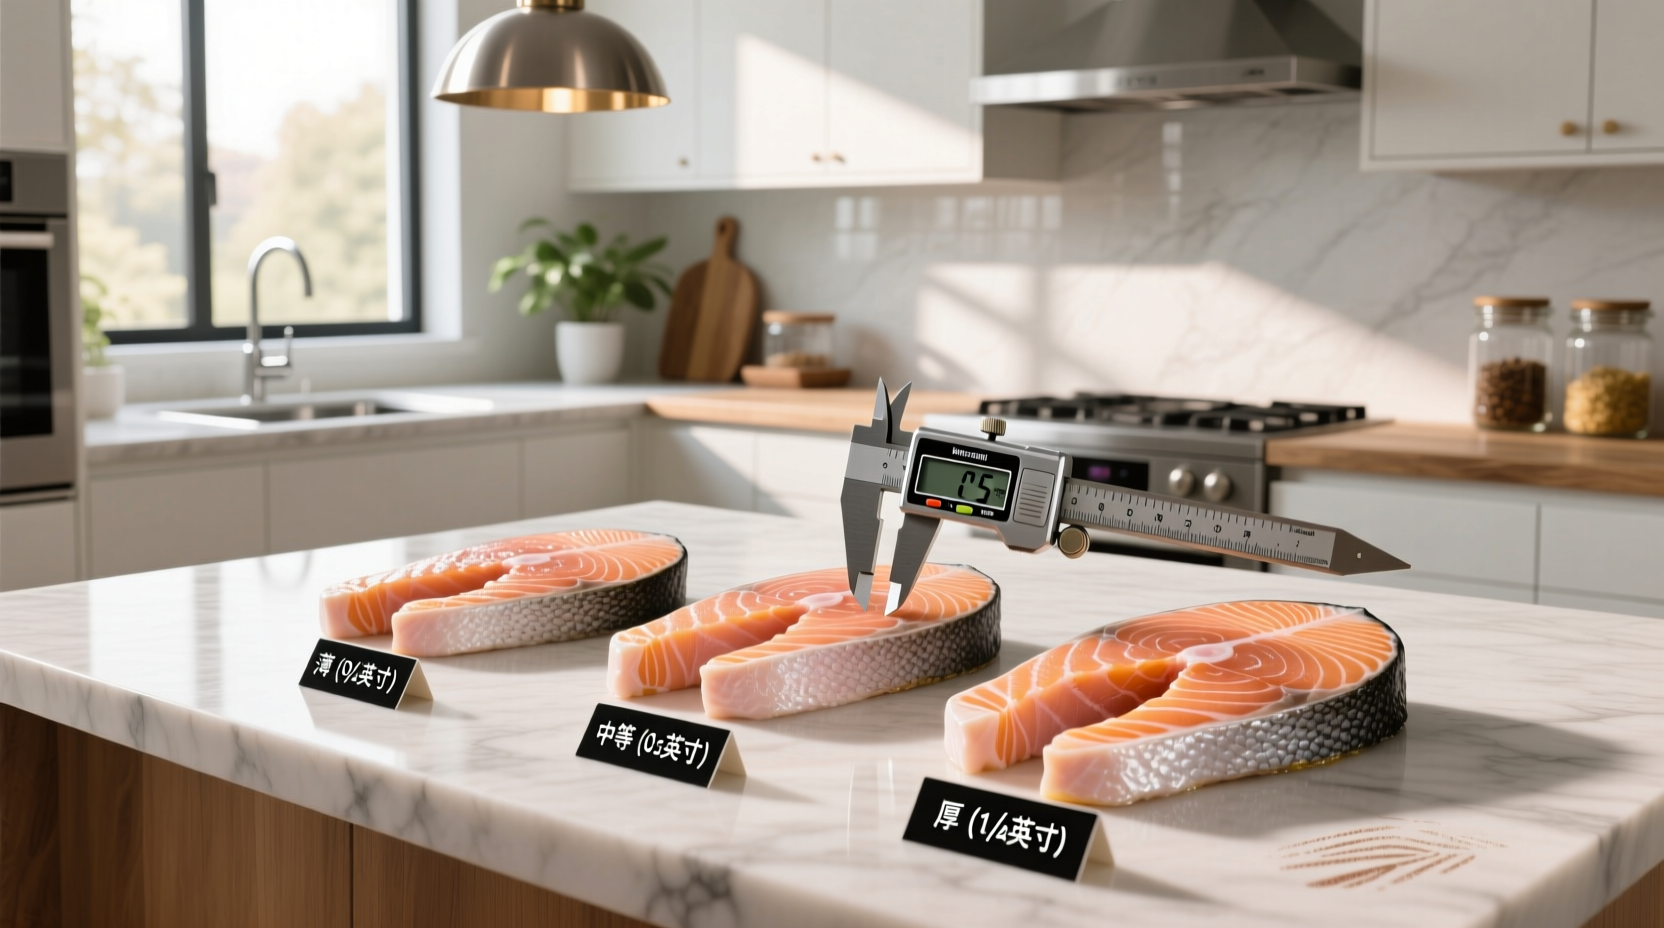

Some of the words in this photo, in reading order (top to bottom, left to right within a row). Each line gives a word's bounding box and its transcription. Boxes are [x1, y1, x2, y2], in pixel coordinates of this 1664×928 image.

[312, 652, 336, 678] 薄
[596, 720, 637, 751] 中等
[933, 799, 965, 831] 厚
